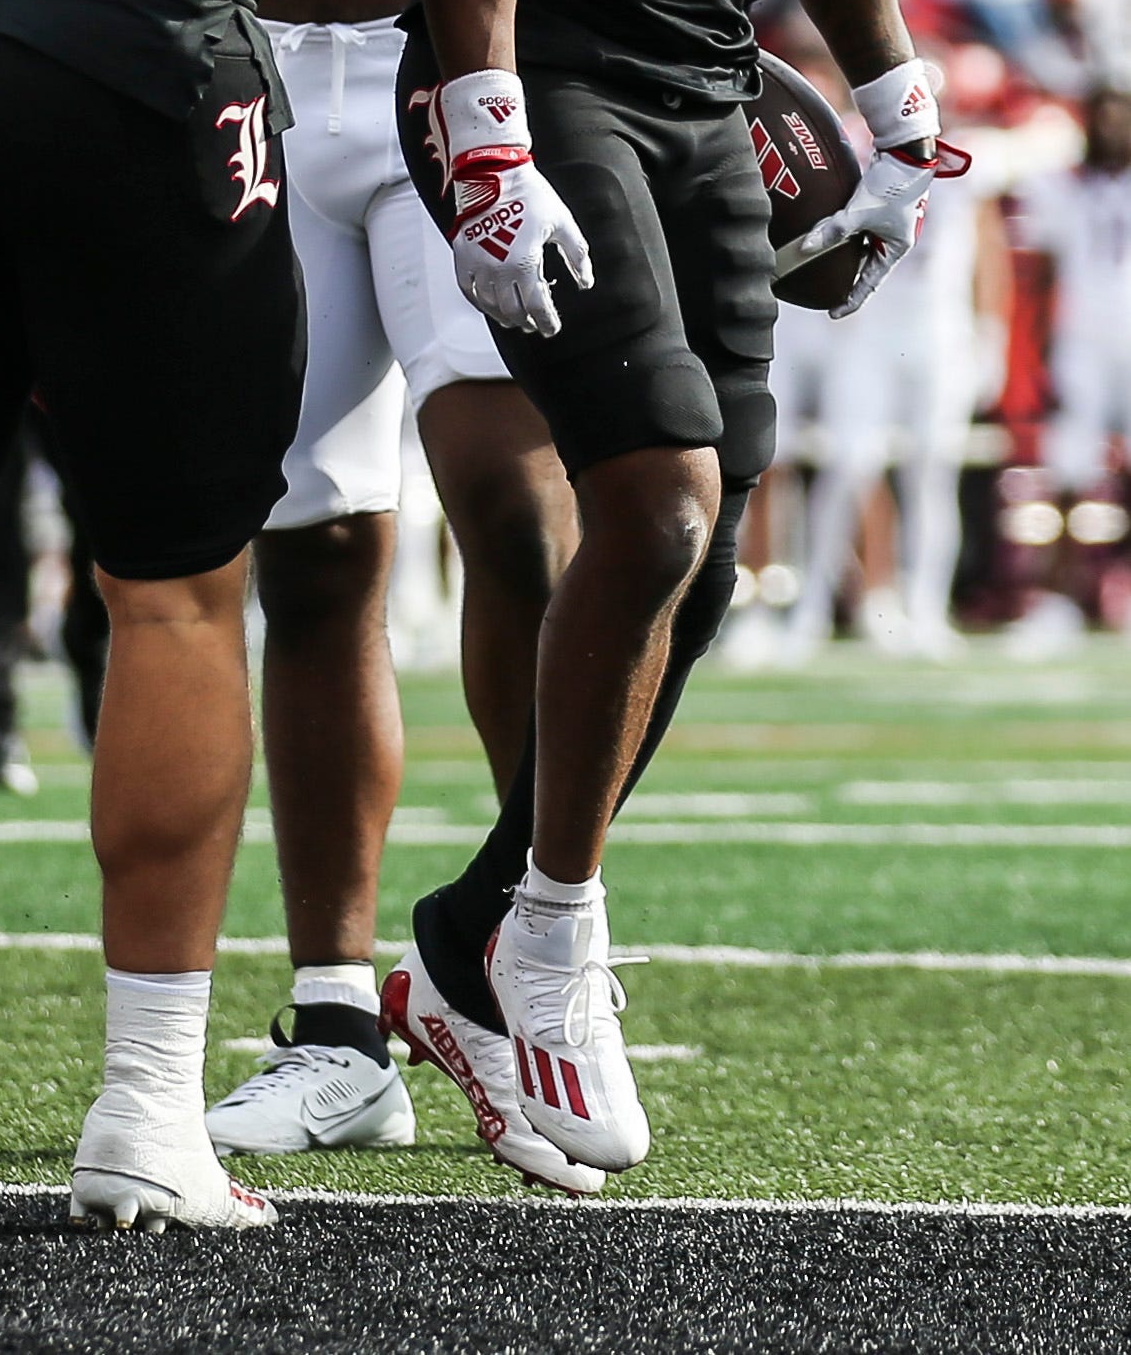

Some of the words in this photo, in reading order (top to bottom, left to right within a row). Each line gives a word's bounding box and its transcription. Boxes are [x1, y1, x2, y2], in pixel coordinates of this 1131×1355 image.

[216, 94, 280, 221] L
[781, 111, 828, 170] DIME
[464, 200, 524, 241] adidas
